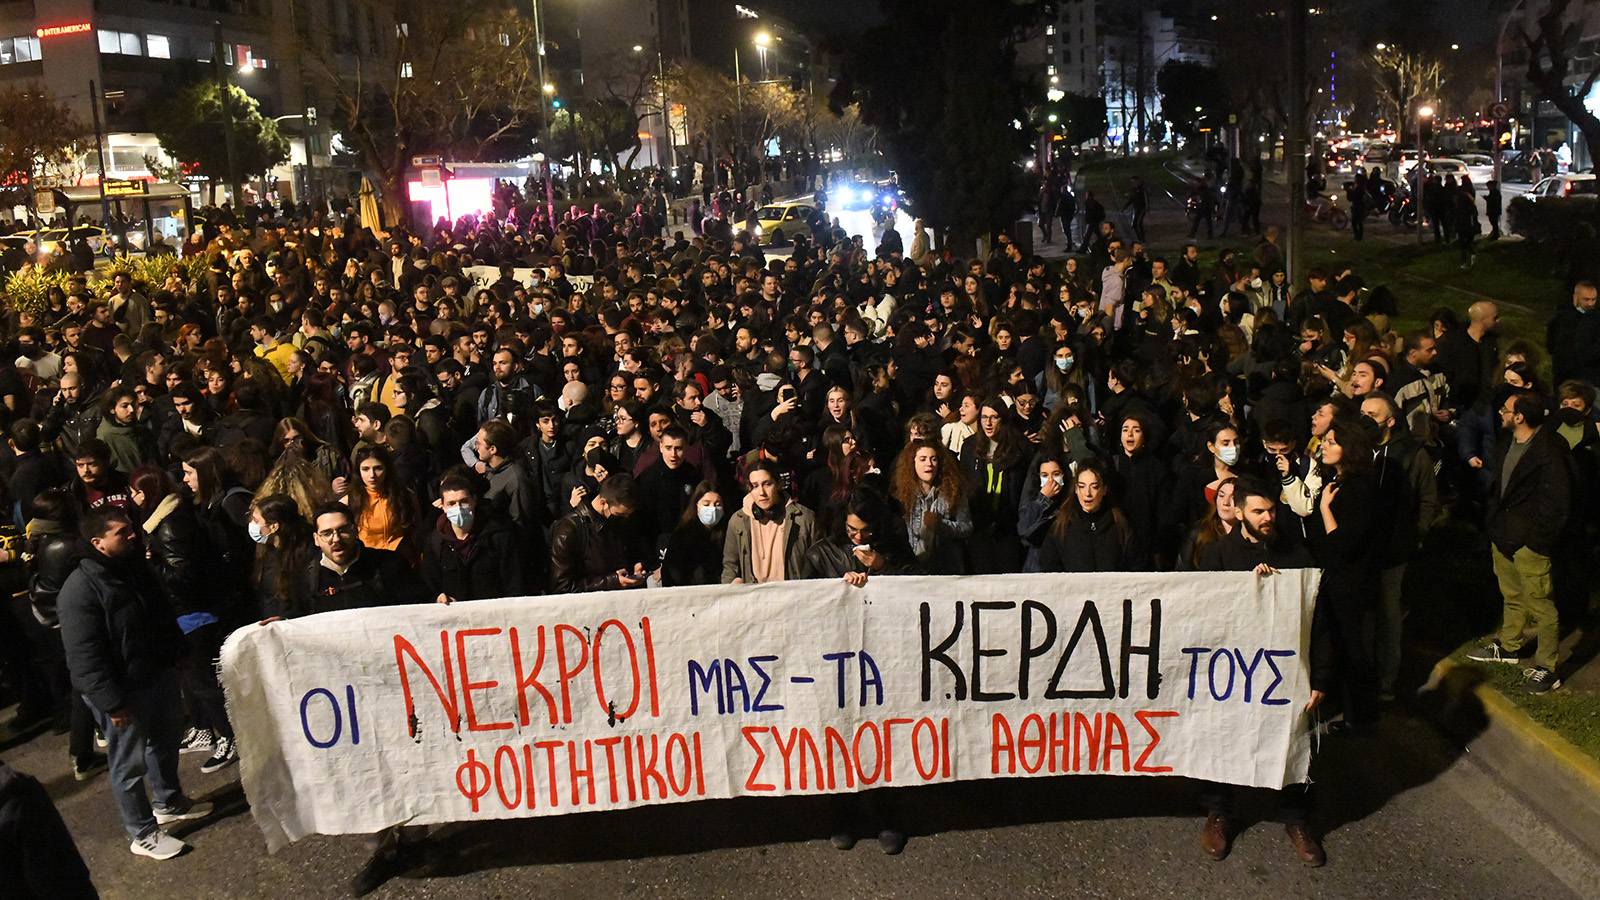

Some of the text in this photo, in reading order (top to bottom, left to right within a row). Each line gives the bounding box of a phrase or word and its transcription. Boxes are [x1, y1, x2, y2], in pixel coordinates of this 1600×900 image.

[44, 23, 91, 36] INTERAMERICAN
[300, 685, 359, 749] ΟΙ
[393, 617, 660, 740] ΝΕΚΡΟΙ
[688, 655, 784, 716] ΜΑΣ
[823, 650, 883, 709] ΤΑ
[920, 599, 1163, 703] ΚΕΡΔΗ
[1181, 647, 1296, 706] ΤΟΥΣ
[455, 711, 1180, 813] ΦΟΙΤΗΤΙΚΟΙ ΣΥΛΛΟΓΟΙ ΑΘΗΝΑΣ
